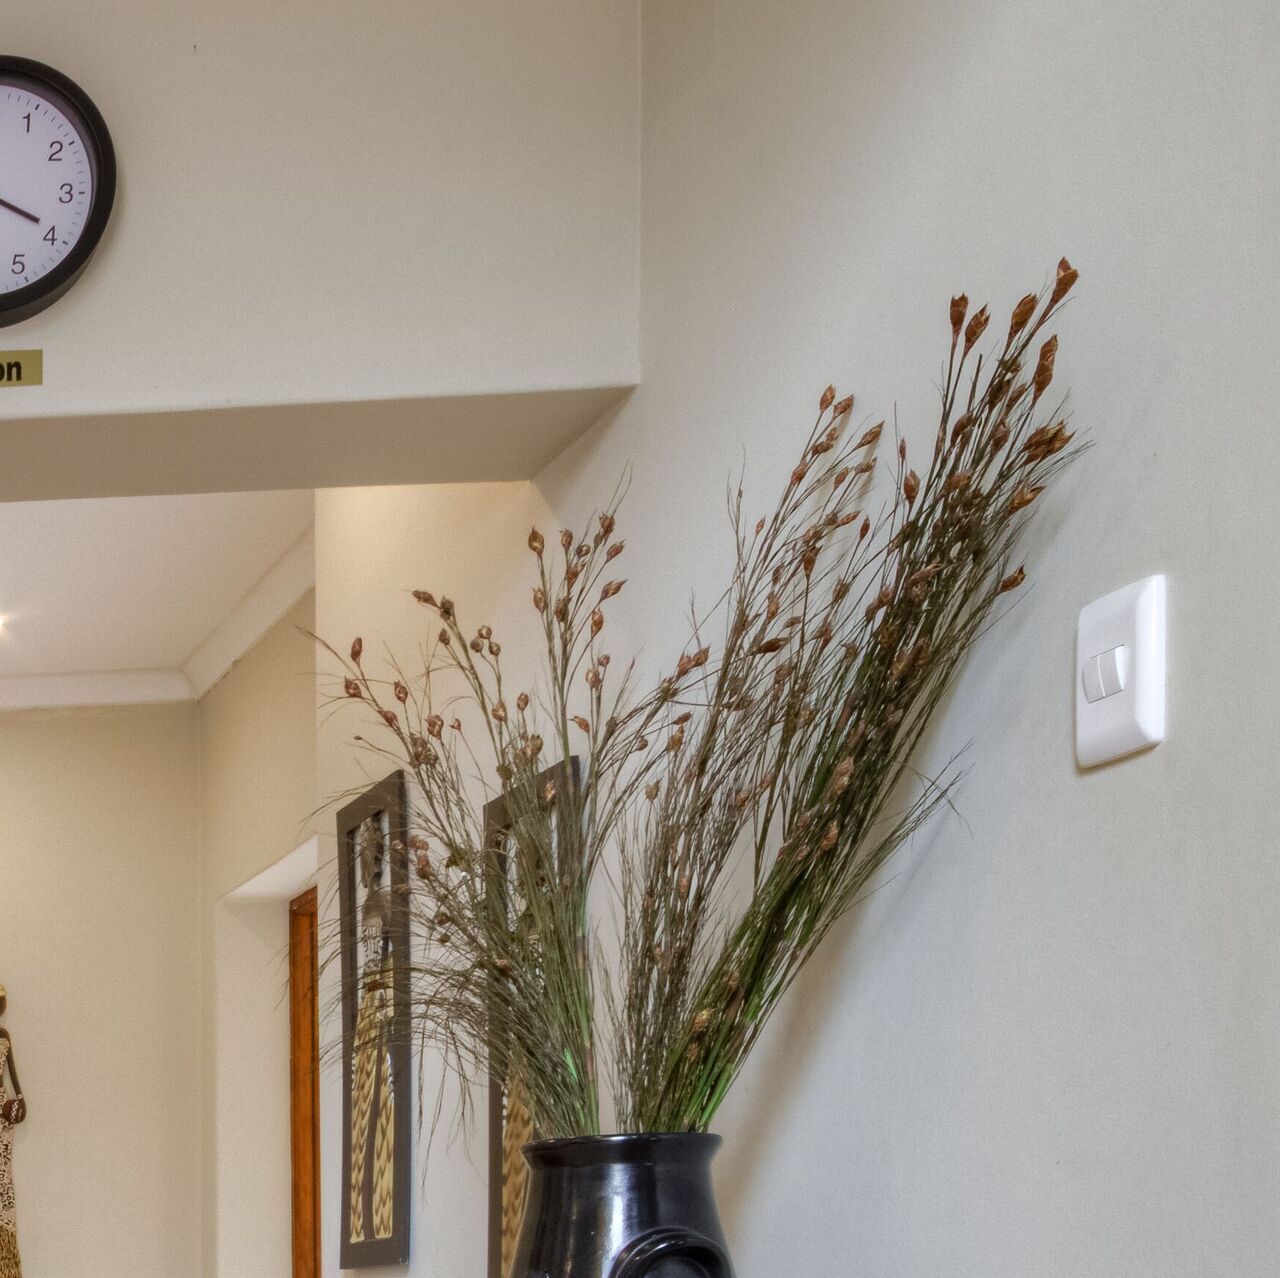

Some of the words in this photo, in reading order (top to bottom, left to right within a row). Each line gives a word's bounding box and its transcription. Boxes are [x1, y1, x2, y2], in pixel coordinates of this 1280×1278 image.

[23, 113, 31, 133] 1
[48, 141, 63, 162] 2
[59, 183, 73, 204] 3
[43, 226, 57, 246] 4
[12, 255, 25, 275] 5
